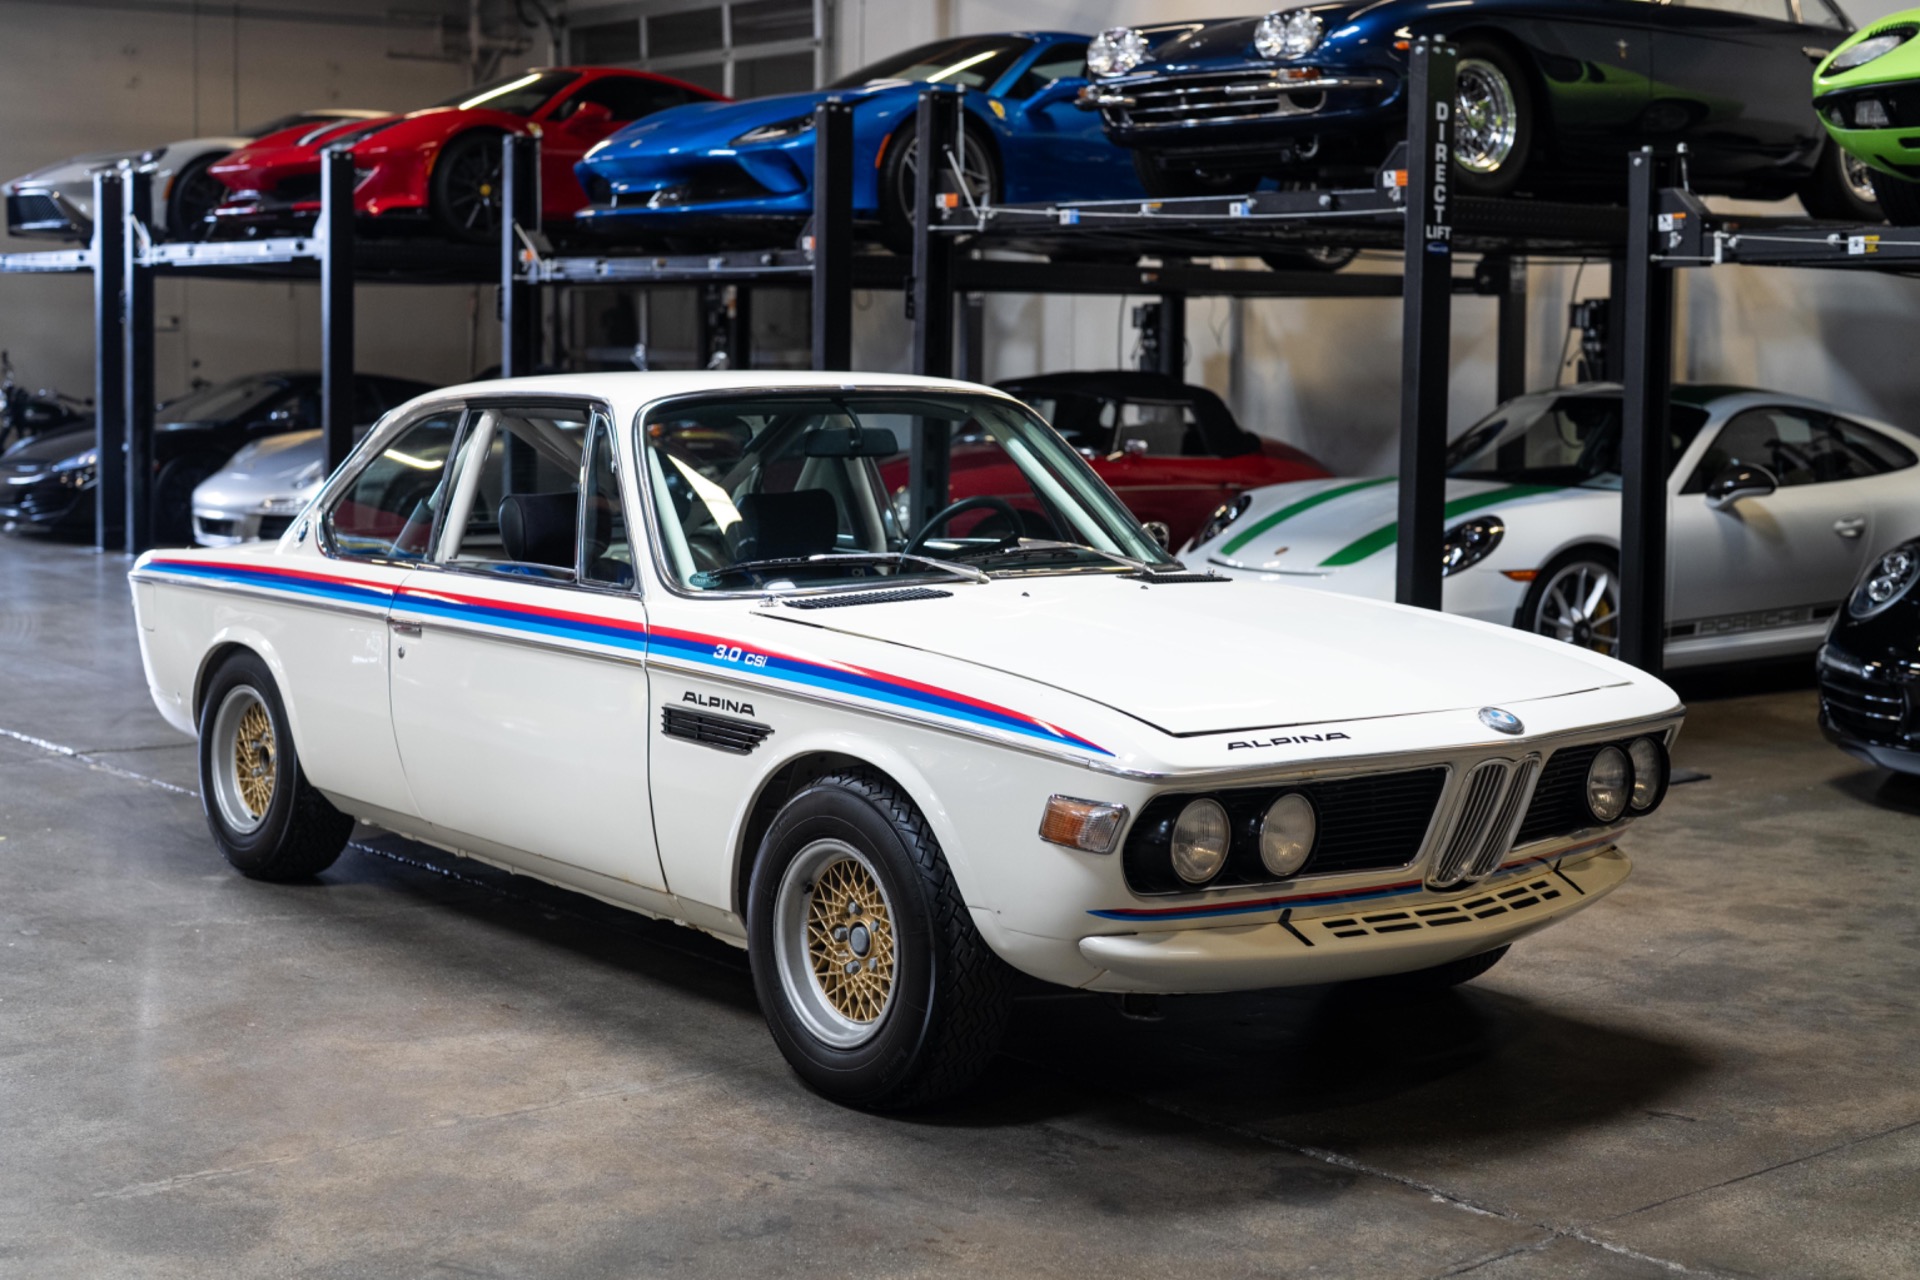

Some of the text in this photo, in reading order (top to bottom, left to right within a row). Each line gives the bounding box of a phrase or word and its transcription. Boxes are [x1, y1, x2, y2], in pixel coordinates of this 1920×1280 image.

[1433, 101, 1449, 223] DIRECT
[1425, 225, 1452, 240] LIFT
[713, 644, 742, 662] 3.0
[682, 691, 755, 716] ALPINA
[1227, 731, 1351, 751] ALPINA
